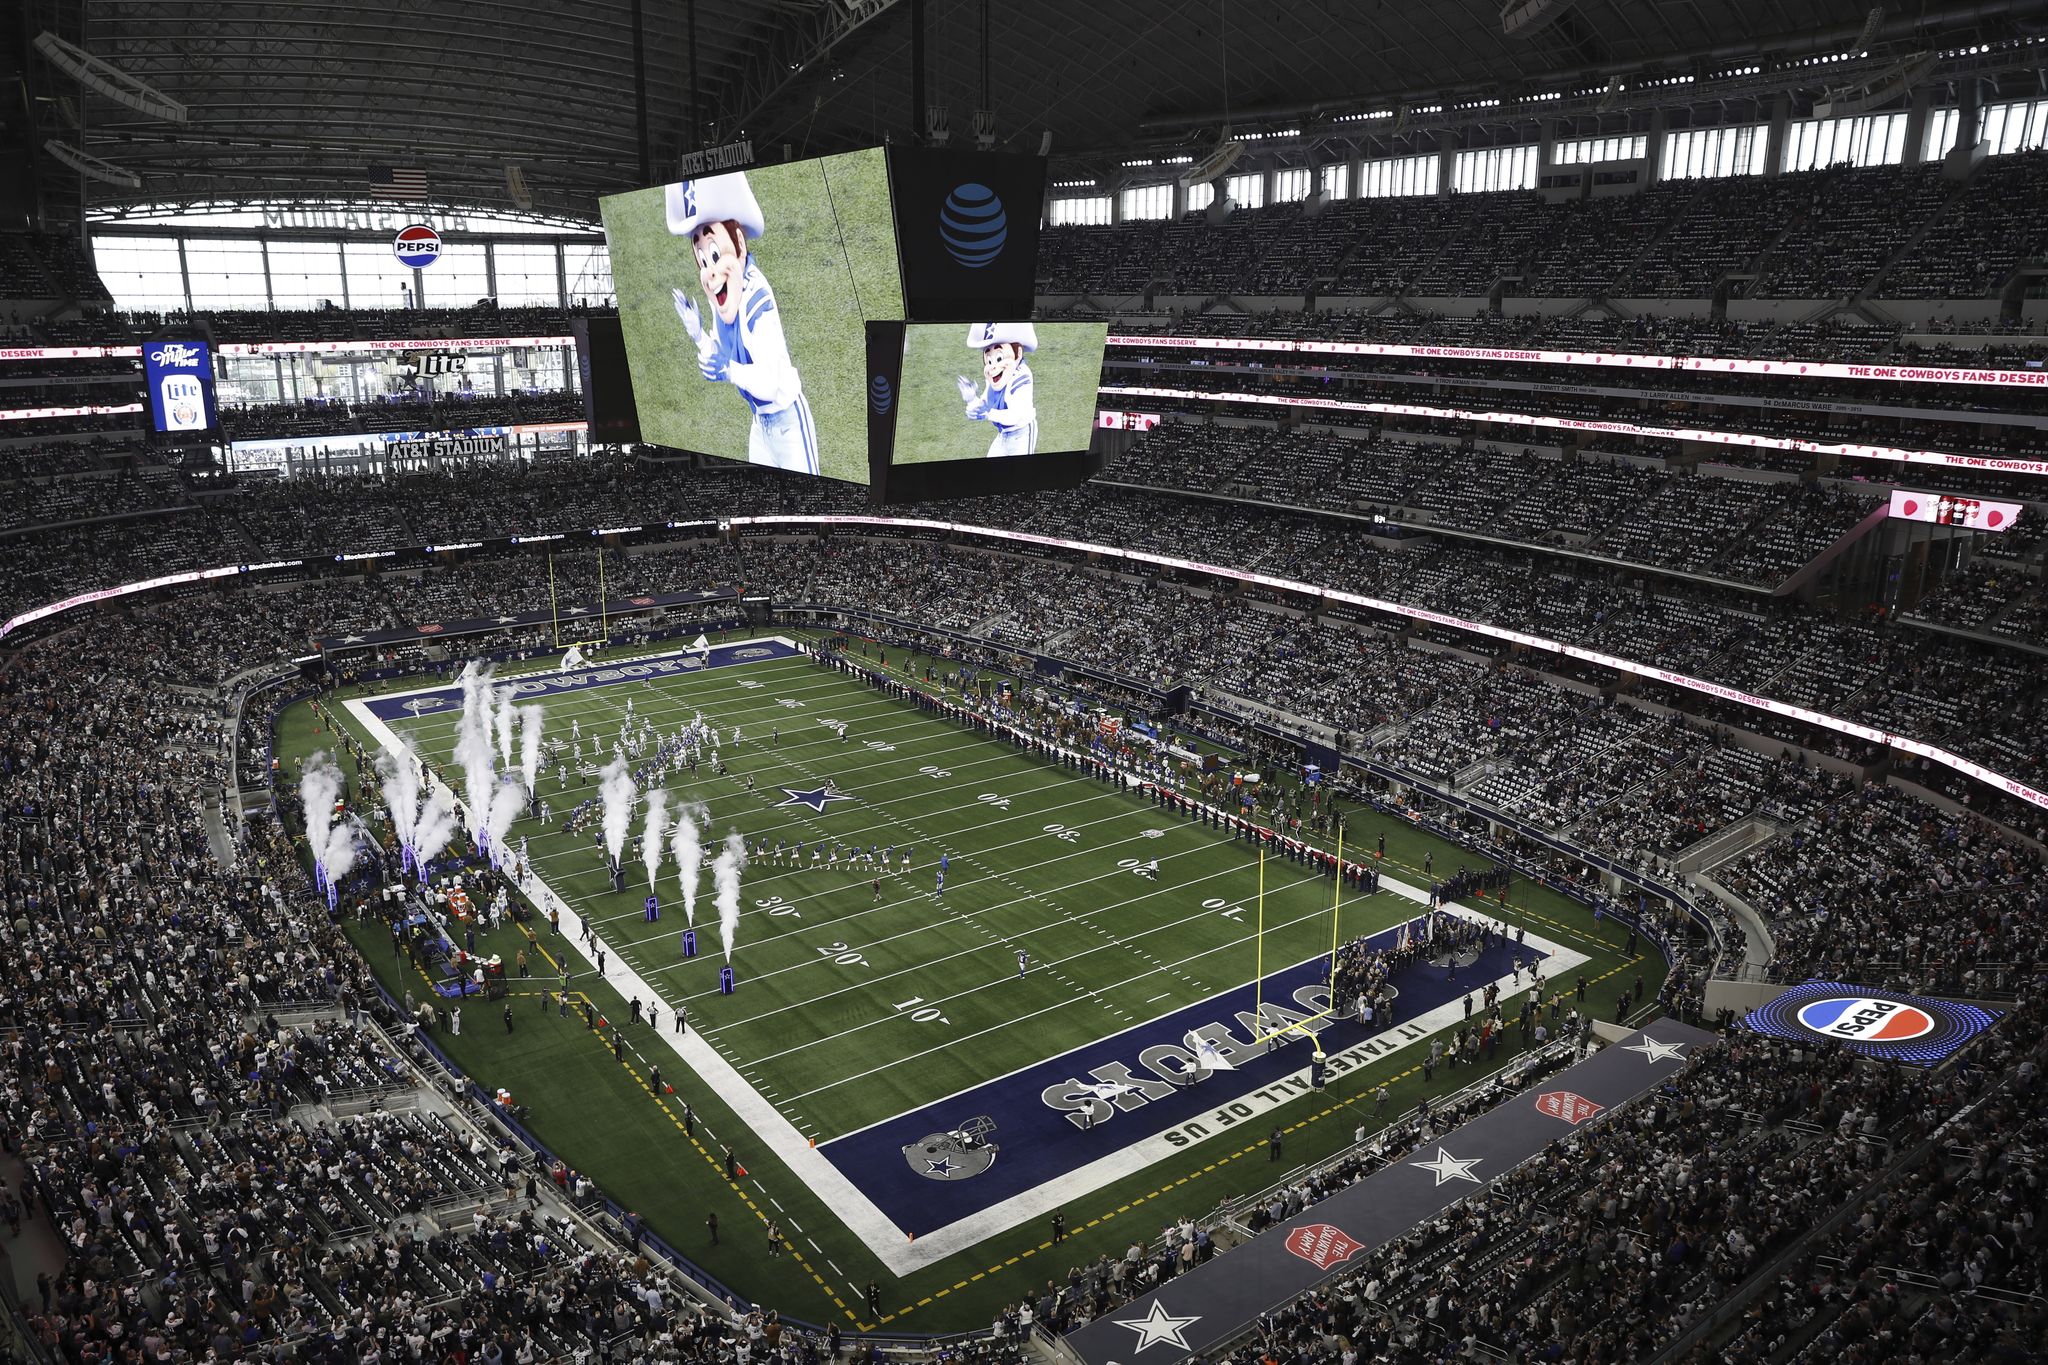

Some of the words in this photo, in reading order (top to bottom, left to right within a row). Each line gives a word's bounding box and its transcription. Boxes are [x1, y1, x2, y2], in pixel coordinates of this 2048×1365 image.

[681, 150, 705, 175] AT&T
[705, 140, 755, 171] STADIUM
[397, 243, 439, 252] PEPSI
[408, 340, 450, 348] COWBOYS
[1, 350, 44, 358] DESERVE
[174, 358, 199, 367] TIME
[1410, 347, 1425, 355] THE
[1426, 348, 1442, 356] ONE
[1443, 349, 1481, 358] COWBOYS
[1481, 350, 1502, 358] FANS
[1503, 351, 1541, 360] DESERVE
[415, 354, 466, 378] Lite
[1848, 367, 1870, 376] THE
[1873, 368, 1897, 377] ONE
[1899, 369, 1960, 380] COWBOYS
[1962, 371, 1996, 382] FANS
[167, 384, 197, 400] Lite
[1812, 403, 1832, 411] WARE
[424, 431, 441, 439] 8:34
[1587, 422, 1621, 431] COWBOYS
[390, 442, 431, 460] AT&T
[434, 438, 504, 457] STADIUM
[1945, 456, 1964, 464] THE
[1966, 458, 1987, 466] ONE
[1989, 460, 2043, 472] COWBOYS
[599, 525, 643, 534] Blockchain.com
[674, 519, 717, 527] Blockchain.com
[433, 541, 483, 551] Blockchain.com
[518, 533, 565, 542] Blockchain.com
[343, 550, 395, 560] Blockchain.com
[248, 559, 303, 570] Blockchain.com
[1204, 565, 1224, 574] COWBOYS
[1235, 571, 1256, 580] DESERVE
[1397, 606, 1406, 614] THE
[1407, 608, 1417, 616] ONE
[1418, 610, 1442, 622] COWBOYS
[1442, 616, 1456, 625] FANS
[1456, 619, 1480, 630] DESERVE
[1659, 671, 1672, 681] THE
[1672, 674, 1686, 685] ONE
[1687, 679, 1719, 693] COWBOYS
[1719, 688, 1737, 699] FANS
[1737, 692, 1770, 708] DESERVE
[918, 765, 952, 778] 50
[2006, 781, 2020, 794] THE
[2021, 788, 2037, 801] ONE
[977, 793, 1012, 810] 40
[1042, 823, 1081, 843] 30
[1117, 858, 1154, 880] 20
[755, 896, 796, 917] 30
[1202, 898, 1247, 918] 10
[816, 941, 863, 966] 20
[892, 996, 941, 1023] 10
[1830, 1002, 1898, 1036] PEPSI
[1396, 1023, 1428, 1041] IT
[1041, 984, 1399, 1131] OWBOYS
[1253, 1075, 1311, 1104] ALL
[1215, 1102, 1254, 1127] OF
[1163, 1122, 1211, 1147] US
[1298, 1228, 1317, 1256] ARMY
[1311, 1225, 1338, 1266] SALVATION
[1332, 1239, 1349, 1258] THE
